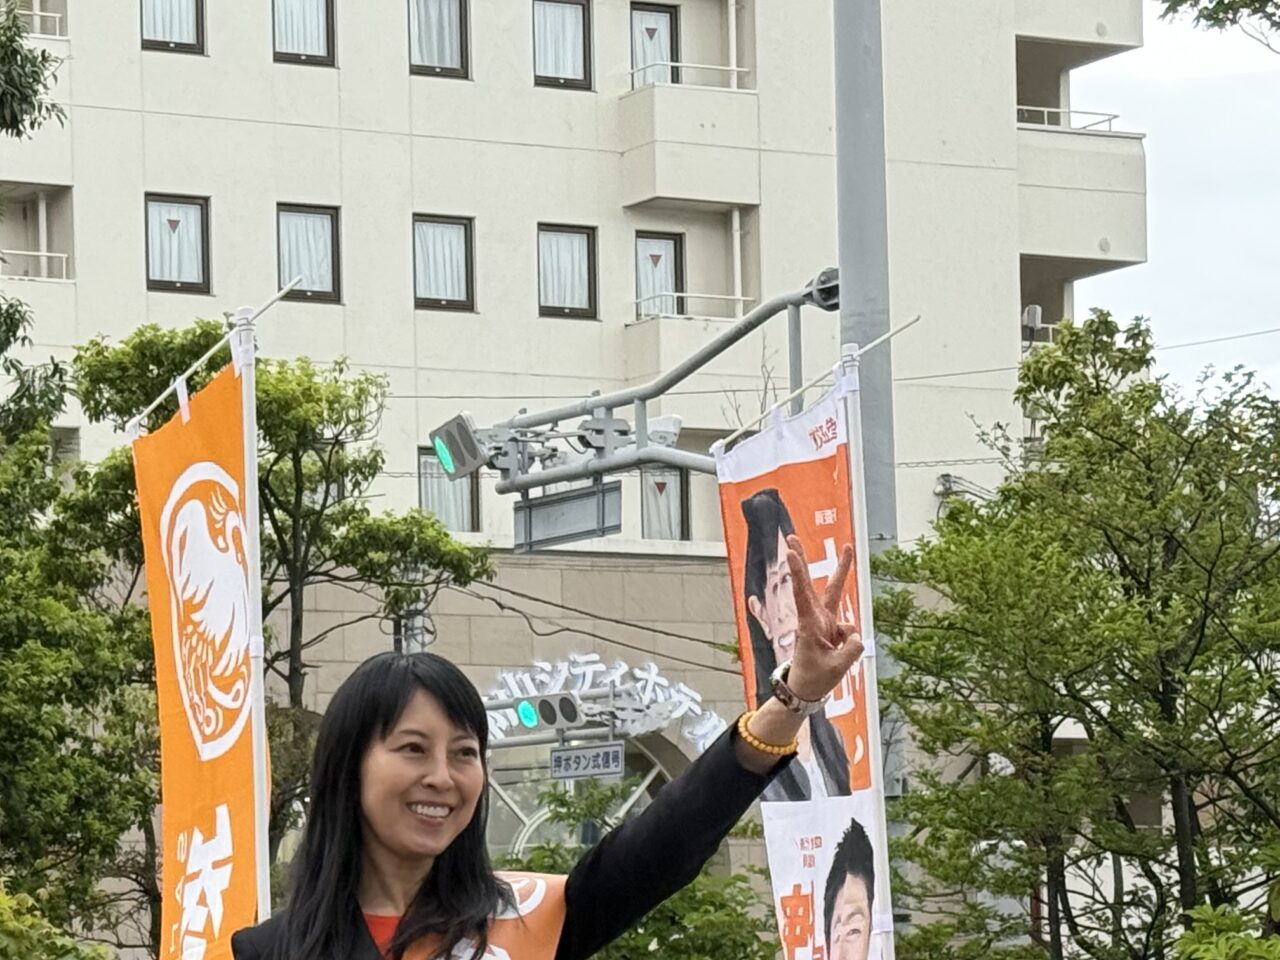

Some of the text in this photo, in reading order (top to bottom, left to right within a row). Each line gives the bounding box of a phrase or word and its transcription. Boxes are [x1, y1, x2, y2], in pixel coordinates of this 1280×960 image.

[553, 750, 620, 774] 押ボタン式信号
